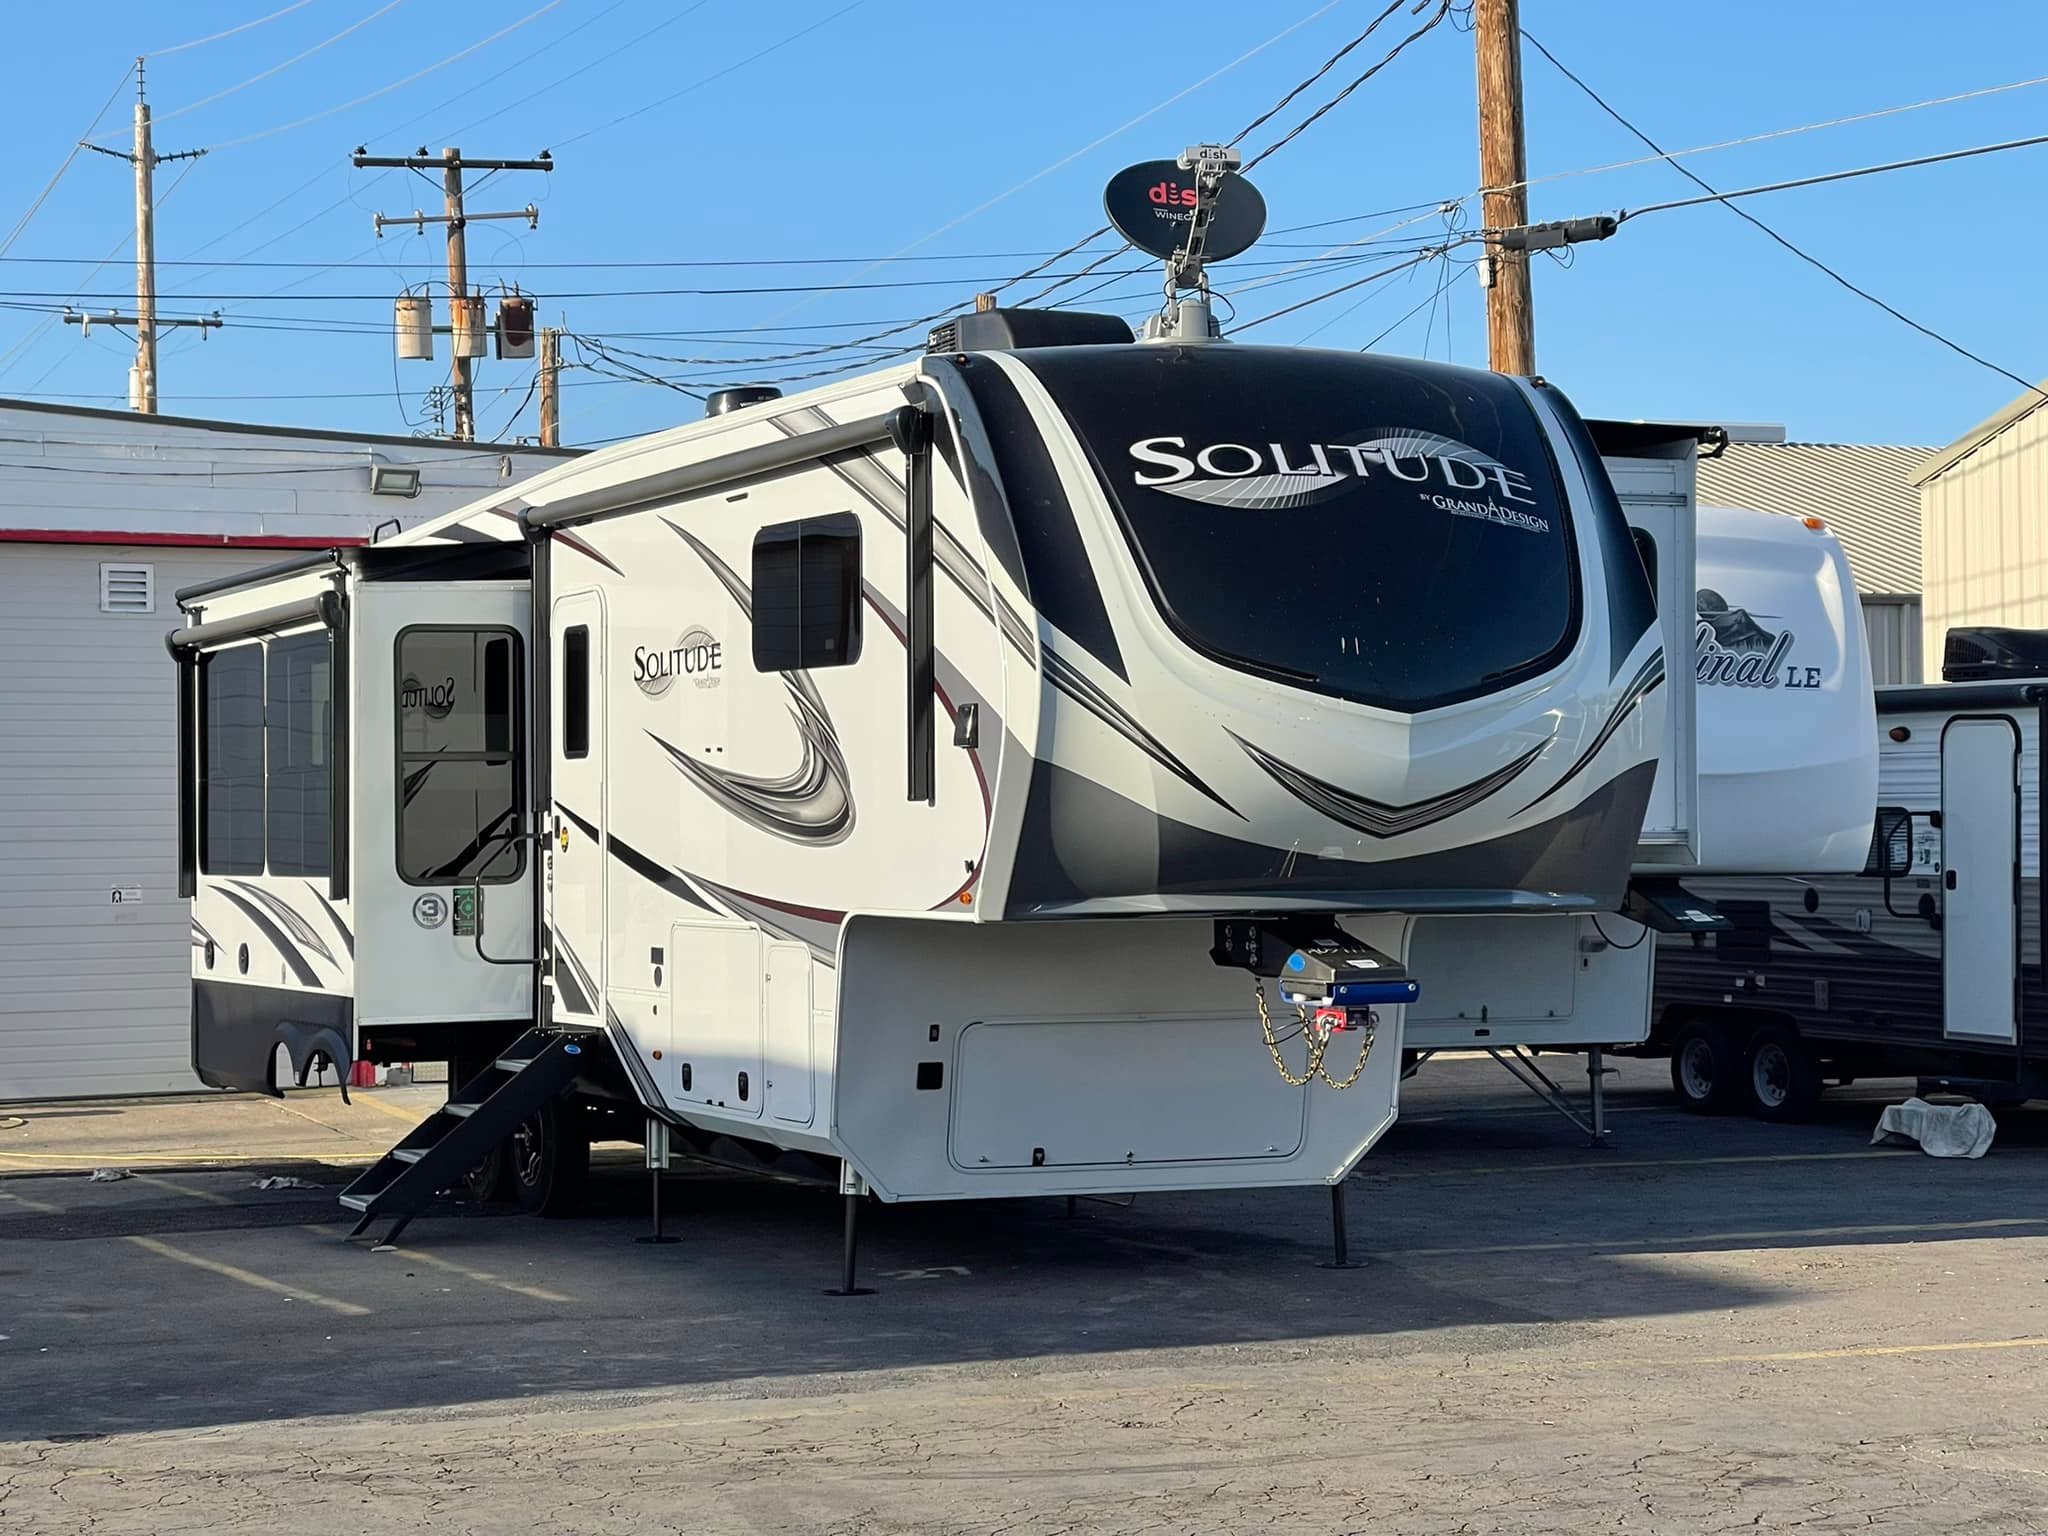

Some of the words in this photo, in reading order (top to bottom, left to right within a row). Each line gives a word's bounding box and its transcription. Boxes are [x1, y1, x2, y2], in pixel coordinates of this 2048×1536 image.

[1200, 148, 1228, 160] dish
[1149, 181, 1198, 207] dis
[1129, 436, 1537, 505] SOLITUDE
[633, 642, 722, 681] SOLITUDE
[1696, 620, 1795, 690] inal
[1785, 665, 1822, 689] LE
[421, 899, 440, 917] 3
